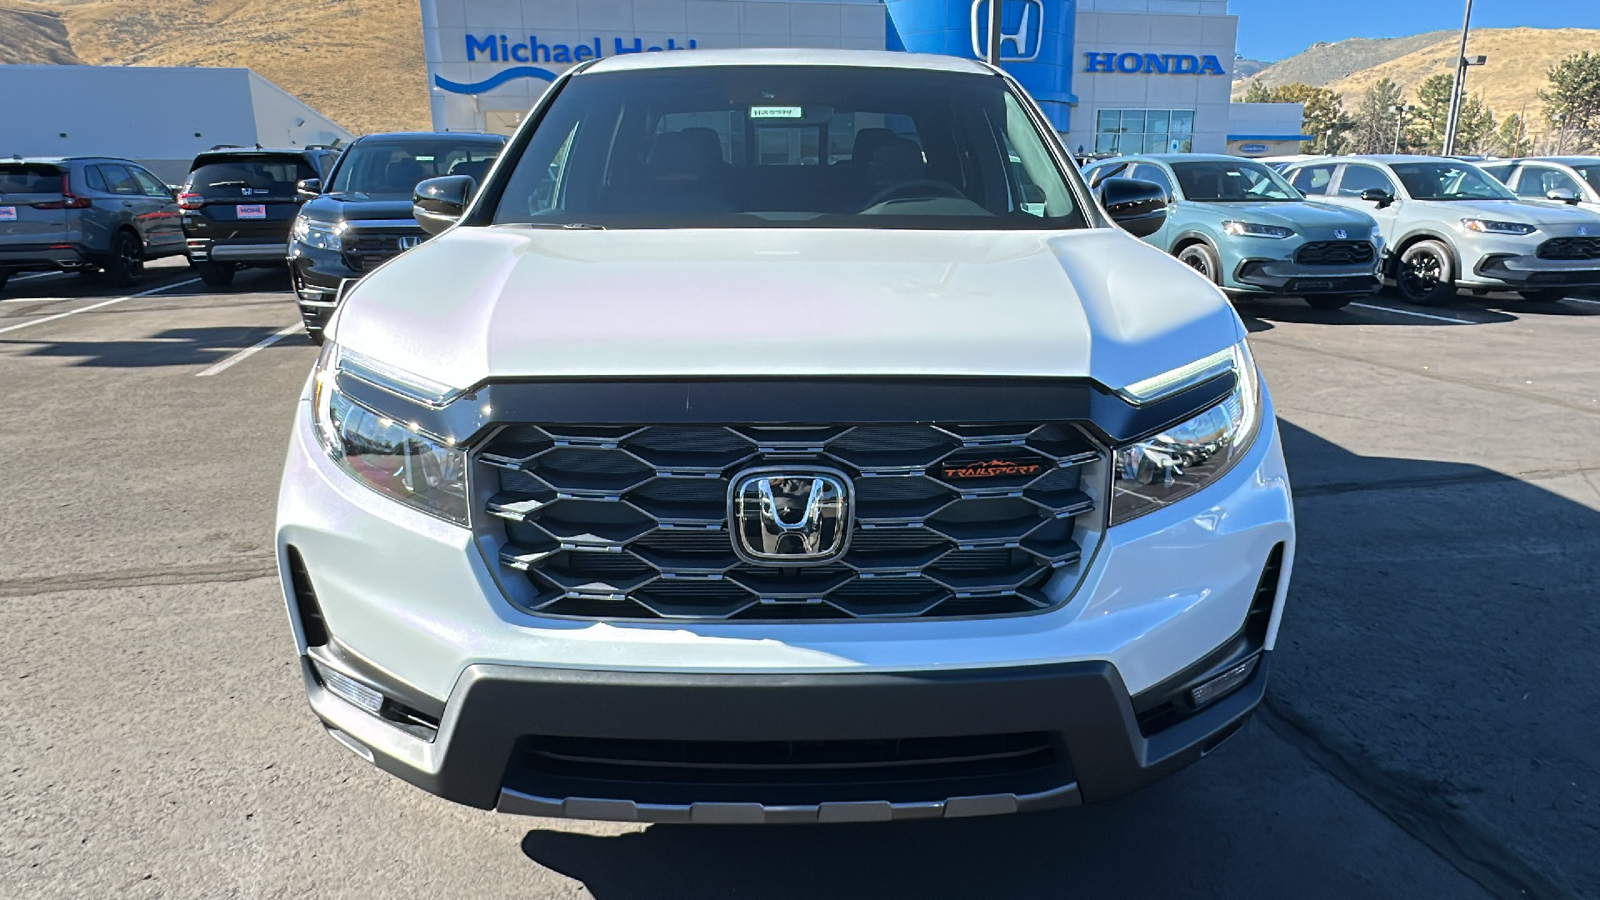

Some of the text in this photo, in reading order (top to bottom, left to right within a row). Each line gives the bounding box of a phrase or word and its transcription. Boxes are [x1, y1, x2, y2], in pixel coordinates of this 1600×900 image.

[465, 34, 602, 62] Michael
[1083, 52, 1225, 75] HONDA
[945, 465, 1039, 478] TRAILSPORT
